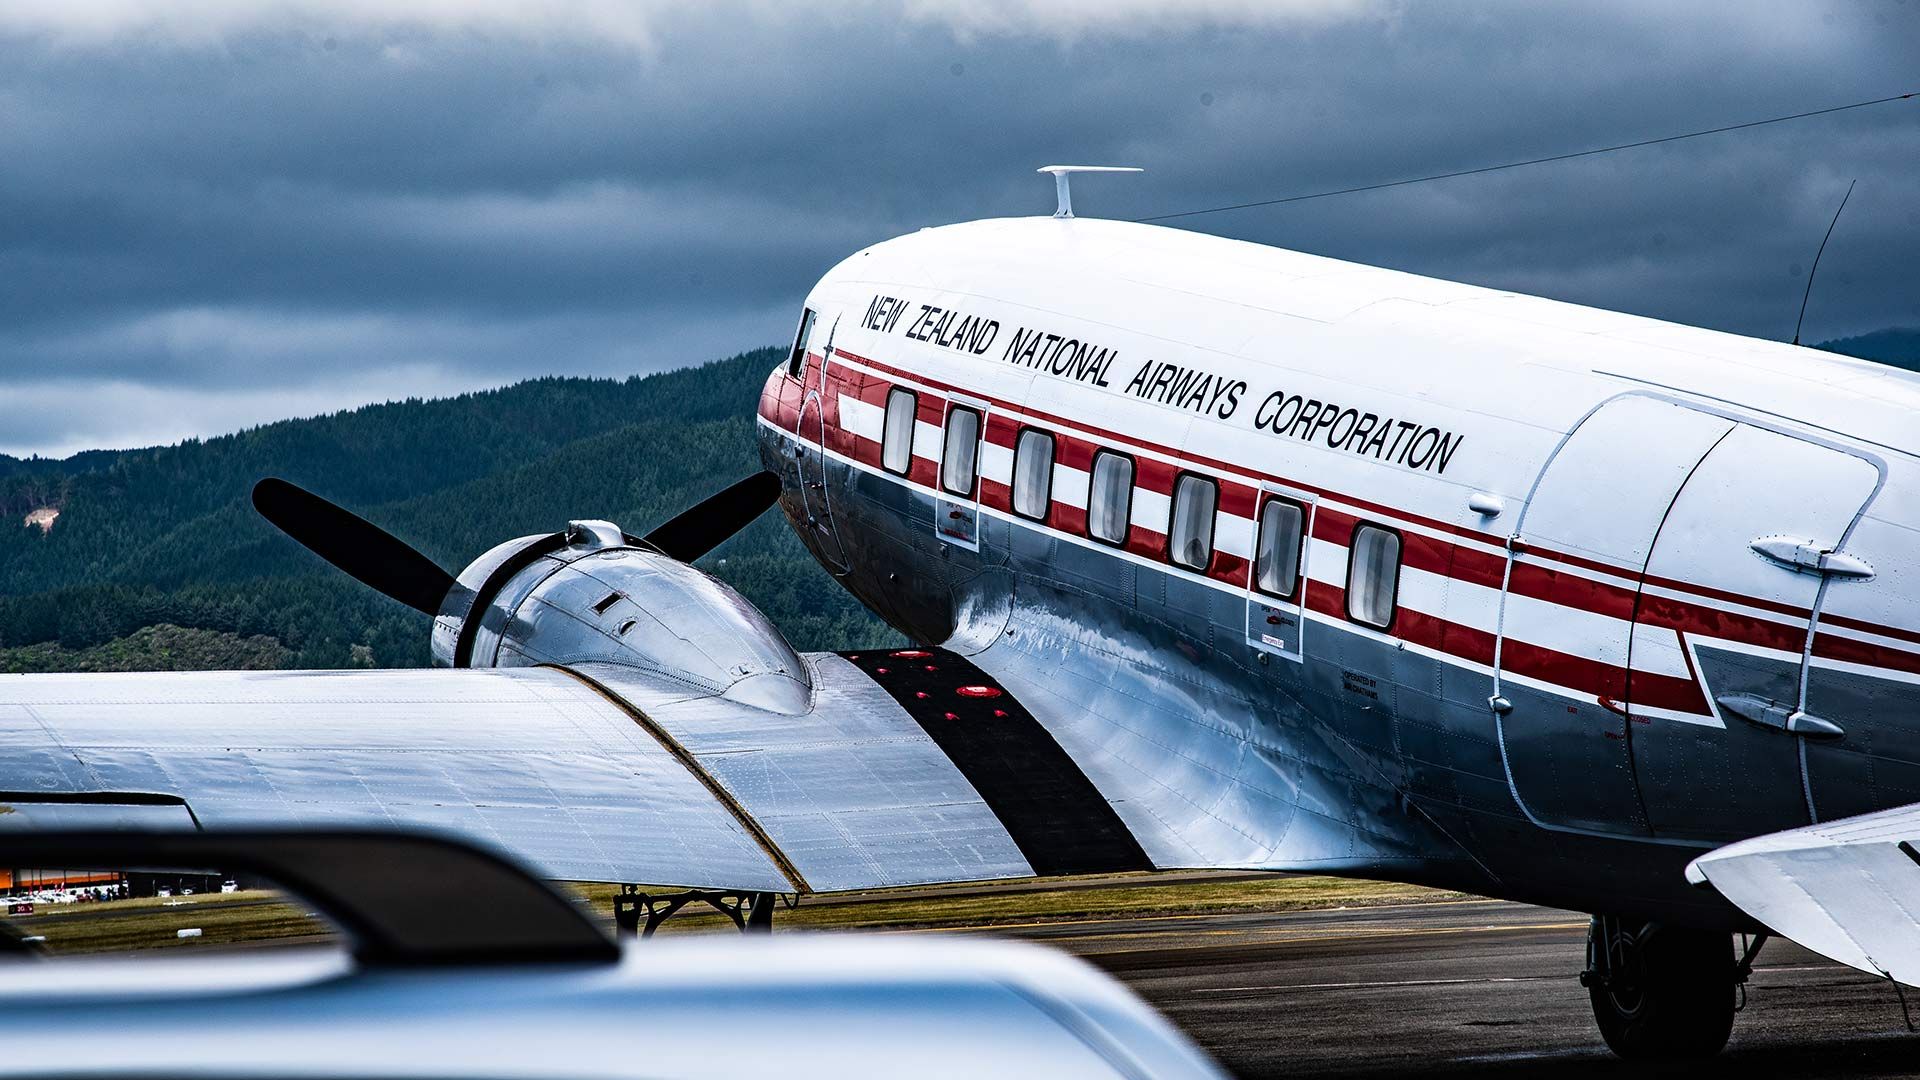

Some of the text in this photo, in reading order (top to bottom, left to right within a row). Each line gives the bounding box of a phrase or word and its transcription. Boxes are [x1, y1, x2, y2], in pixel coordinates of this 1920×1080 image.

[861, 295, 1465, 475] NEW ZEALAND NATIONAL AIRWAYS CORPORATION
